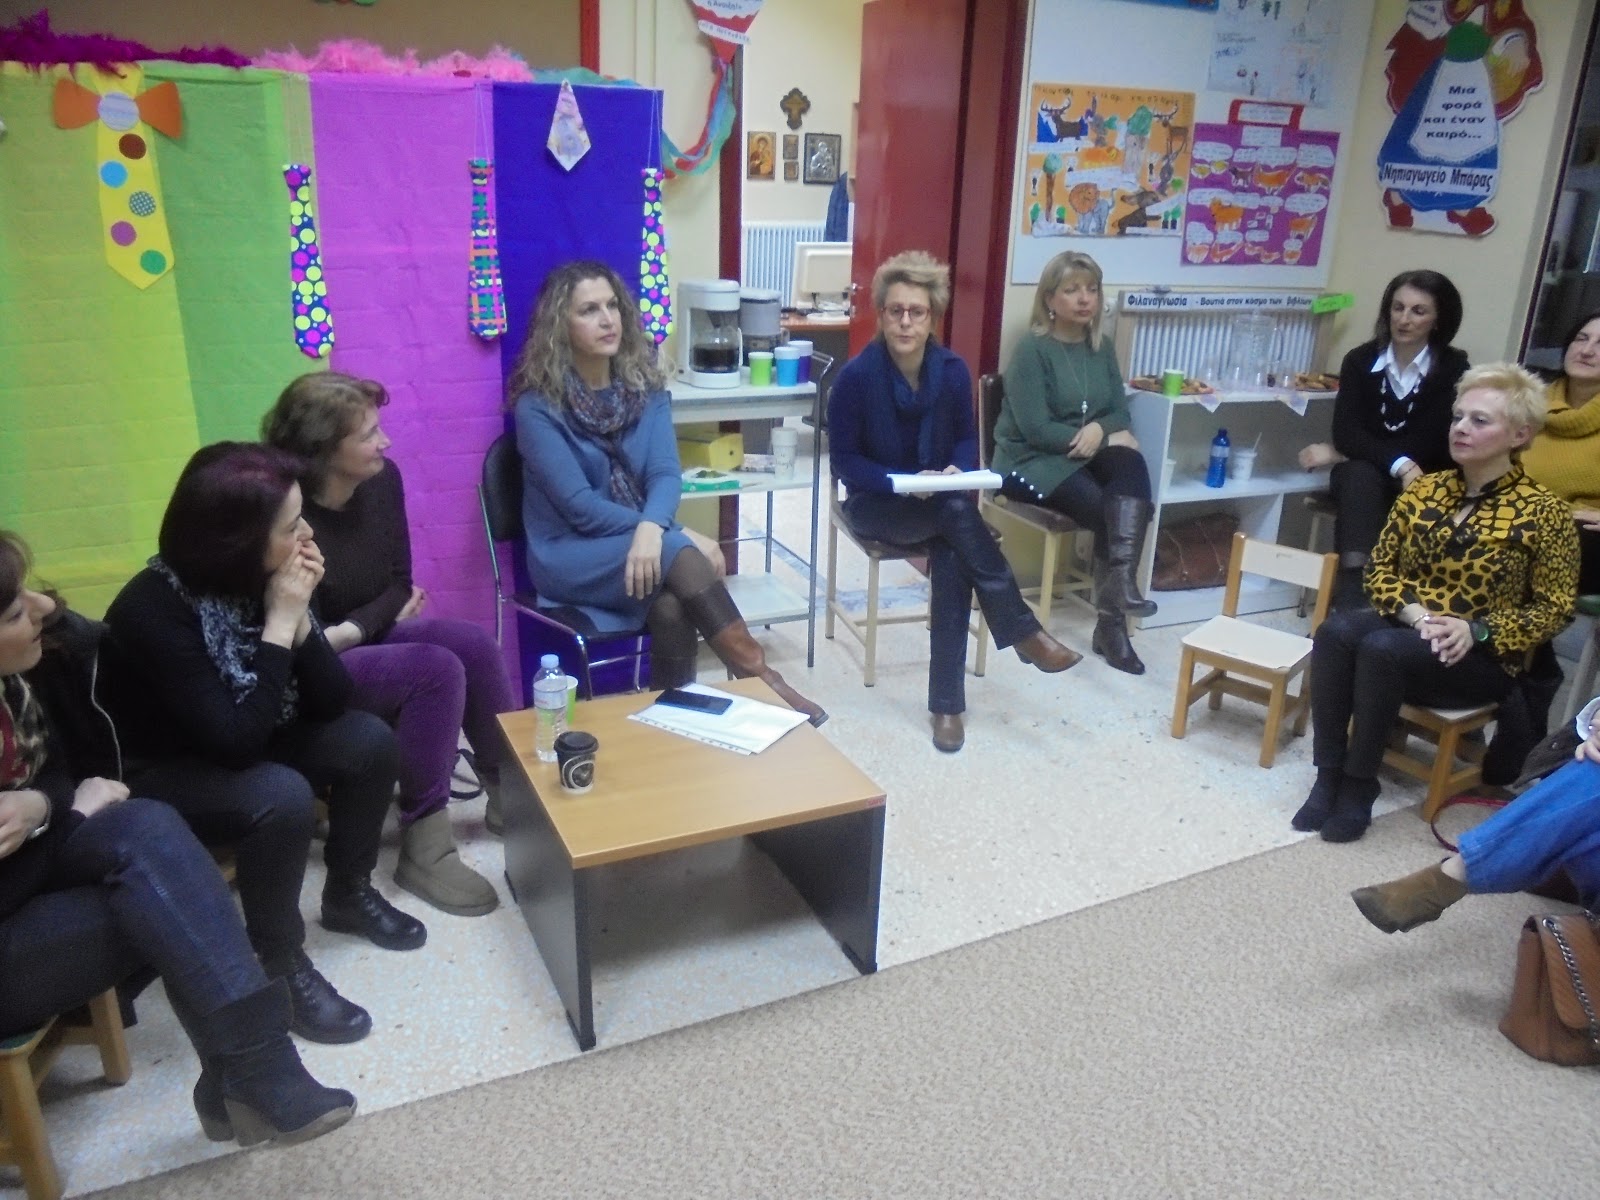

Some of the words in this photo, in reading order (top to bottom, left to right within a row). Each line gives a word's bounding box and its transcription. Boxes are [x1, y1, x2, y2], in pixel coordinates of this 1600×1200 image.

[1448, 85, 1477, 95] Μια
[1441, 101, 1482, 111] φορά
[1450, 115, 1486, 124] έναν
[1426, 130, 1481, 140] καιρό...
[1384, 165, 1446, 186] Νηπιαγωγείο
[1450, 168, 1493, 193] Μπάρας
[1127, 294, 1188, 308] Φιλαναγνωσία
